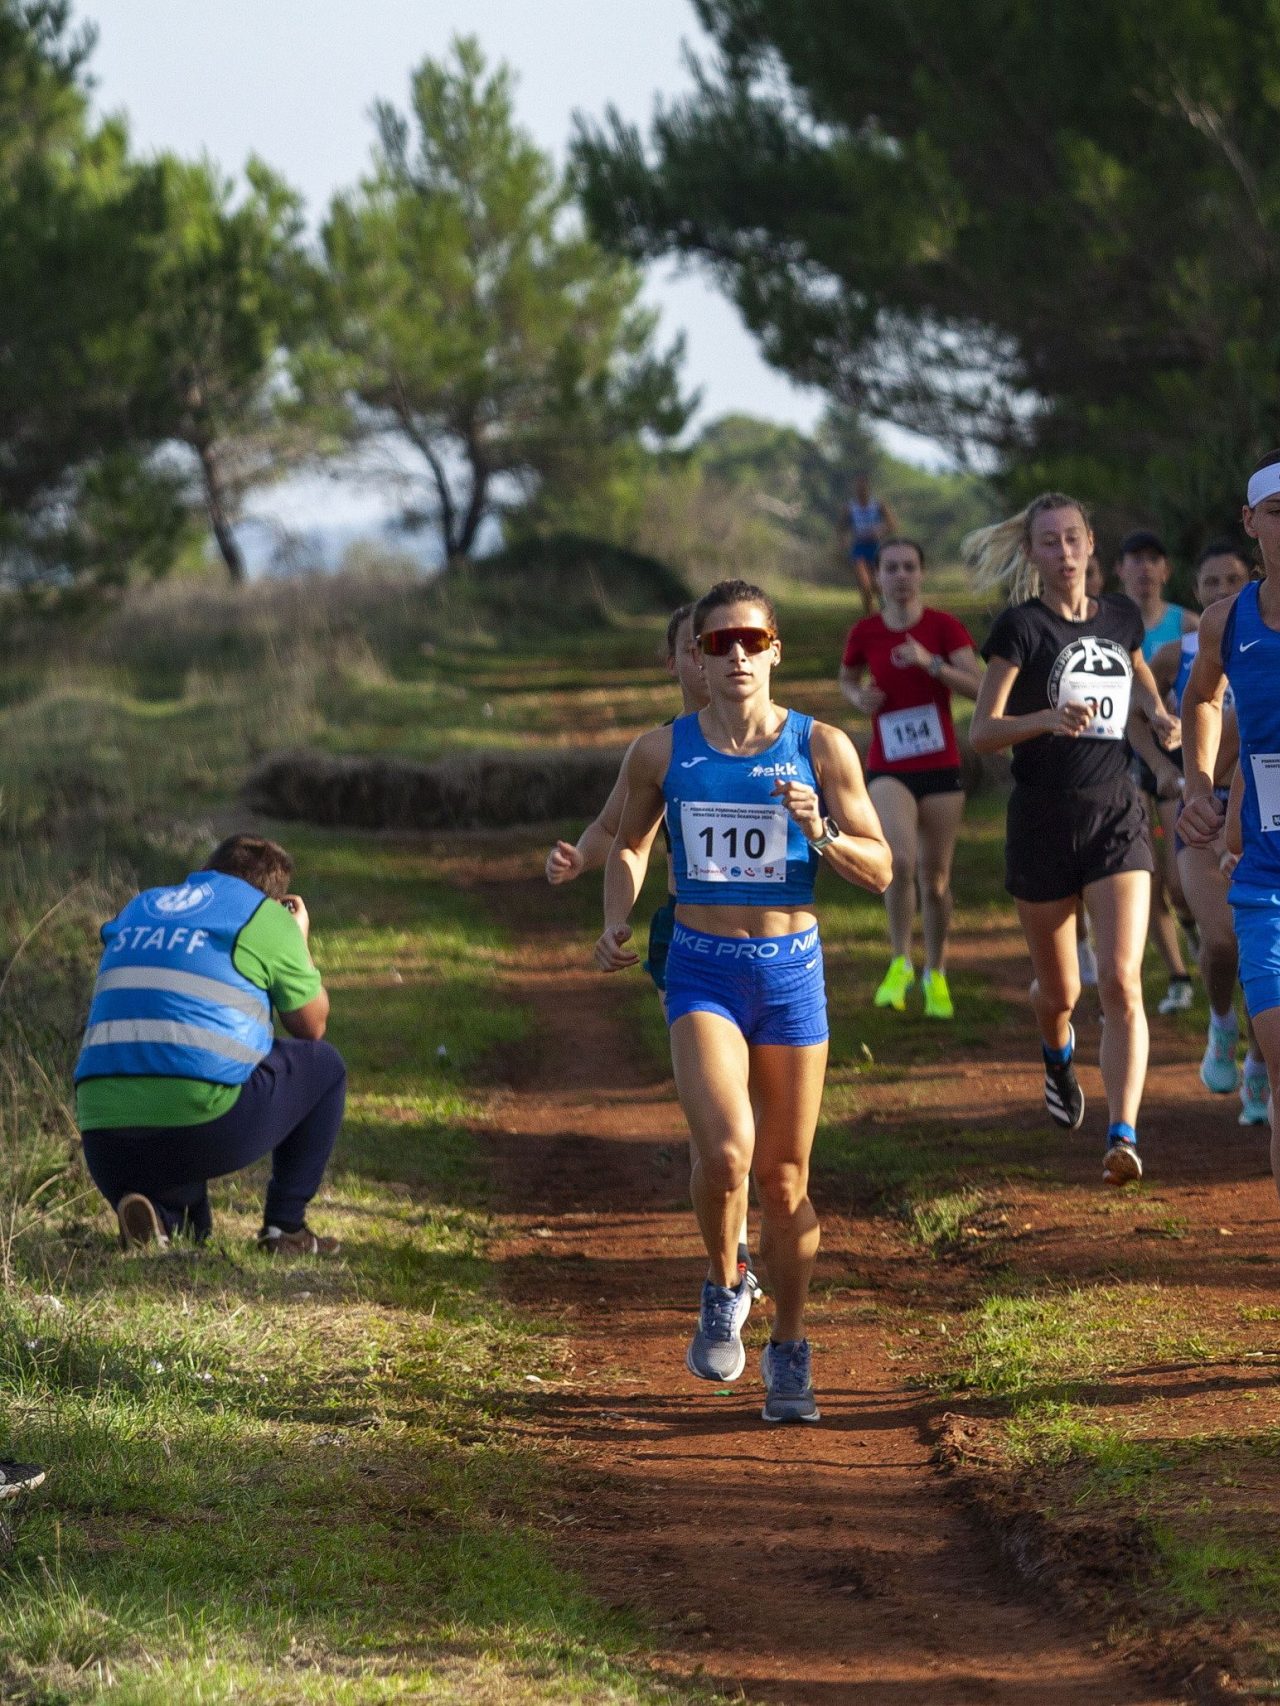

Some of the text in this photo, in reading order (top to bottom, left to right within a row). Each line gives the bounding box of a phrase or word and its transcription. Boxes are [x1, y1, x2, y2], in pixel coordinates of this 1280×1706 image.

[1080, 637, 1112, 671] A
[893, 720, 930, 744] 154
[699, 827, 765, 859] 110
[113, 926, 209, 954] STAFF
[716, 942, 779, 959] PRO
